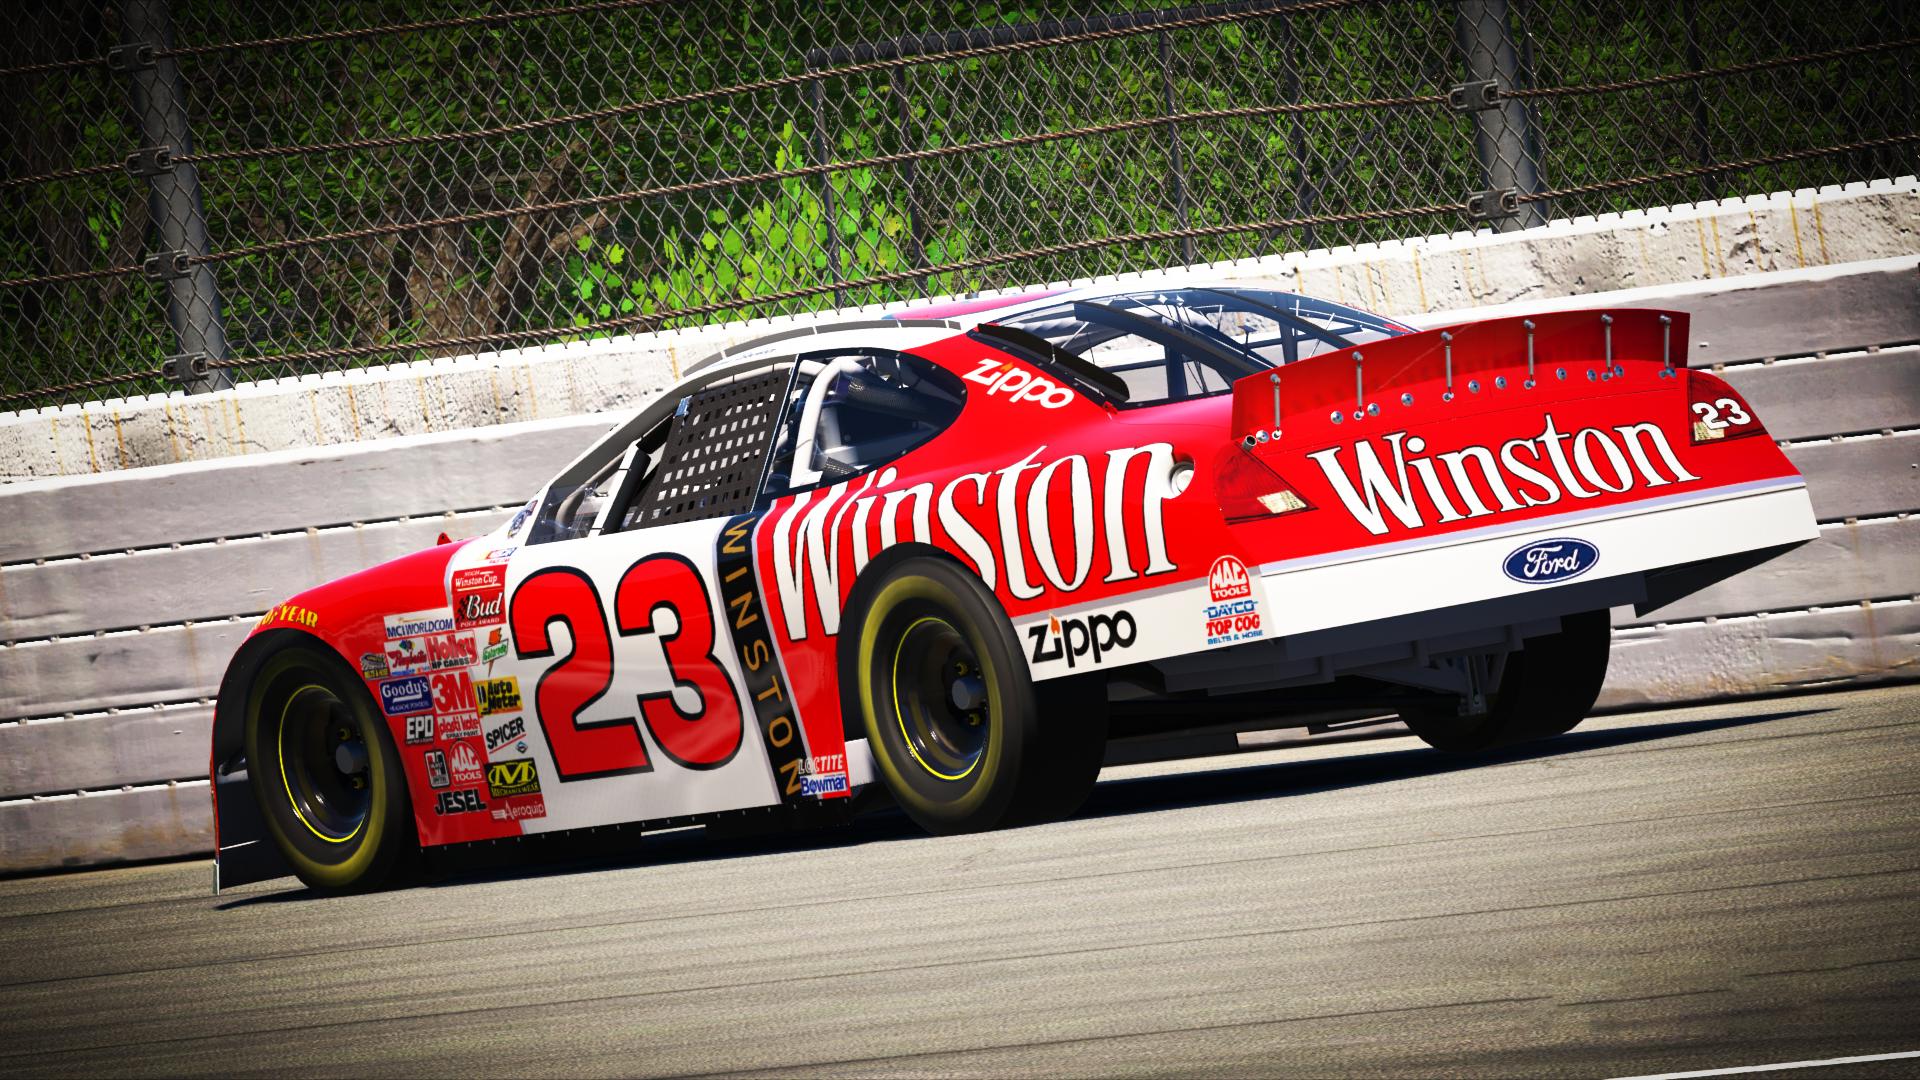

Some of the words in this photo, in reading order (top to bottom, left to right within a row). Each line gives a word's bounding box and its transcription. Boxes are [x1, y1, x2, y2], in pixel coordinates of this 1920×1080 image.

[1691, 398, 1751, 430] 23
[1307, 413, 1703, 536] Winston
[772, 444, 1178, 642] Winston
[1211, 560, 1248, 590] MAC
[1523, 545, 1580, 578] Ford
[456, 577, 483, 588] Winston
[483, 574, 498, 585] Cup
[1213, 585, 1249, 599] TOOLS
[466, 592, 504, 620] Bud
[1206, 600, 1256, 618] DAYCO
[1206, 619, 1232, 637] TOP
[1235, 614, 1260, 632] COG
[427, 633, 477, 664] Holley
[1208, 634, 1232, 645] BELTS
[509, 551, 744, 784] 23
[721, 516, 803, 796] WINSTON
[382, 680, 429, 699] Goody's
[432, 671, 475, 713] 3M
[487, 681, 513, 695] Auto
[487, 694, 521, 711] Meter
[486, 716, 525, 750] SPICER
[451, 745, 480, 773] MAC
[798, 754, 844, 774] LOCTITE
[454, 771, 482, 782] TOOLS
[800, 775, 847, 795] Bowman
[435, 789, 487, 816] JESEL
[504, 800, 544, 820] Aeroquip
